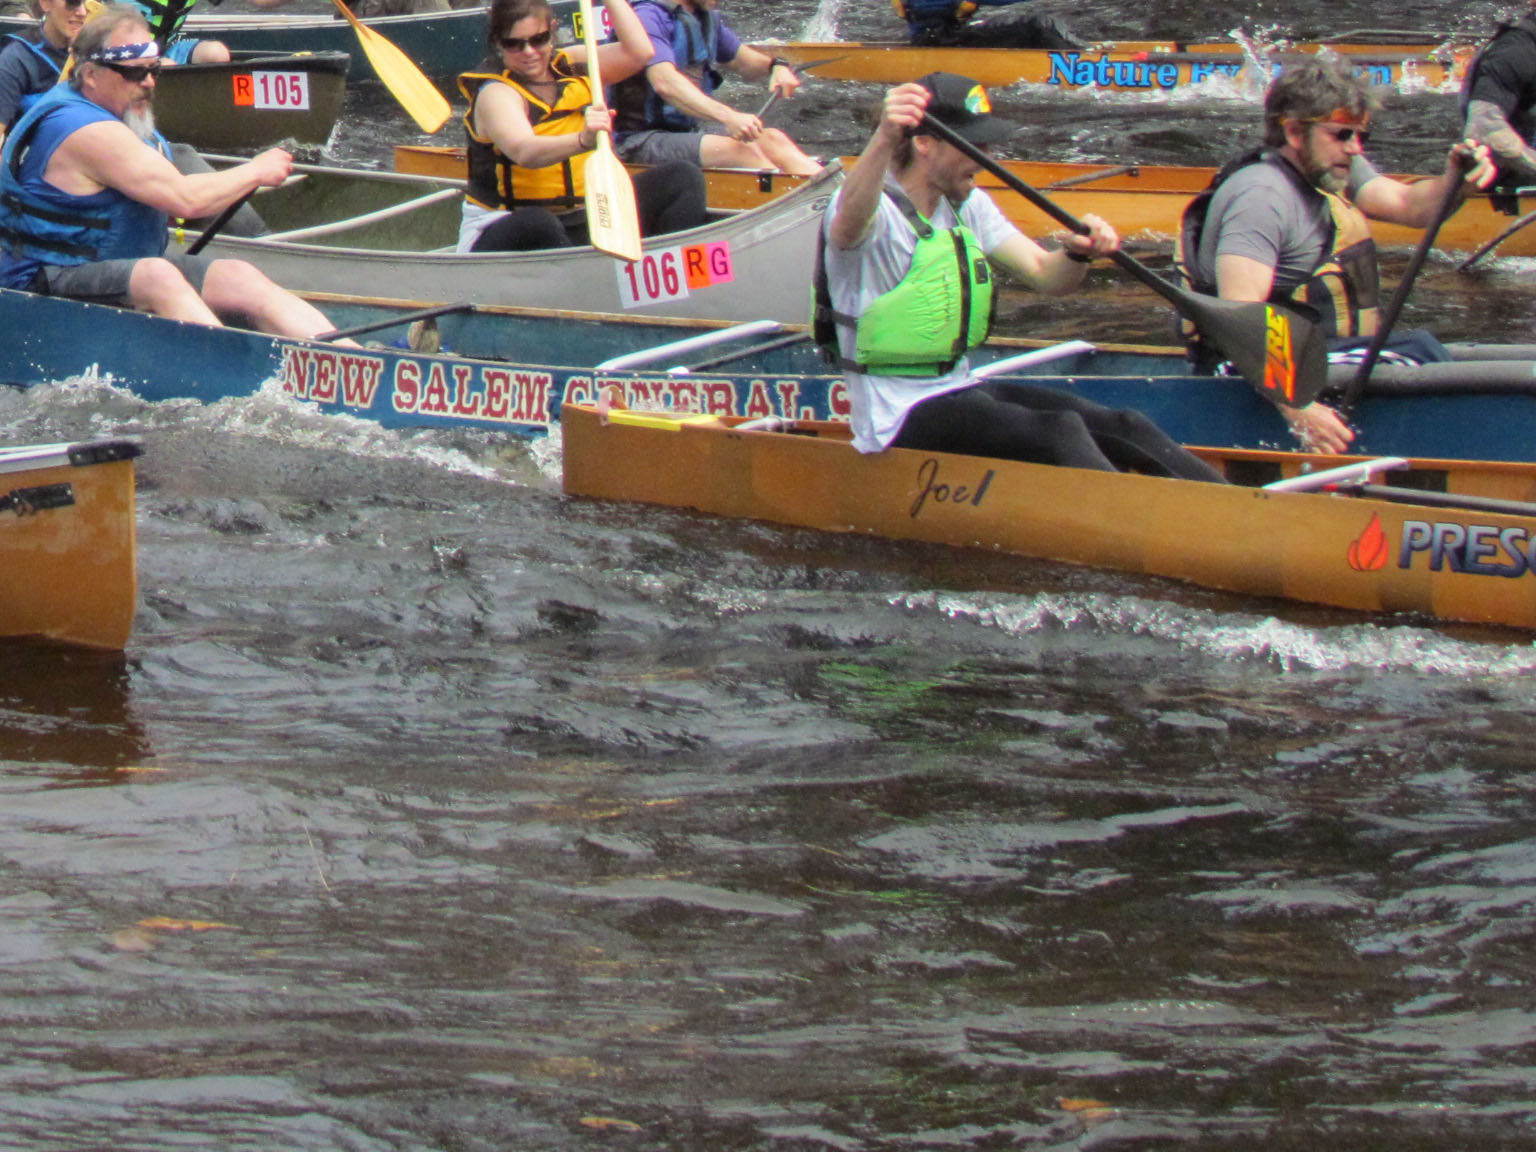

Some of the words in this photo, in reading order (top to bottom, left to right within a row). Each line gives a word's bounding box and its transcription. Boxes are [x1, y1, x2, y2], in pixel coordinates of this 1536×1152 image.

[236, 76, 250, 97] R
[260, 74, 303, 106] 105
[1048, 51, 1179, 89] Nature
[624, 251, 680, 302] 106
[281, 345, 384, 409] NEW
[392, 358, 554, 426] SALEM
[910, 458, 996, 519] Joel
[1397, 519, 1536, 579] PRES
